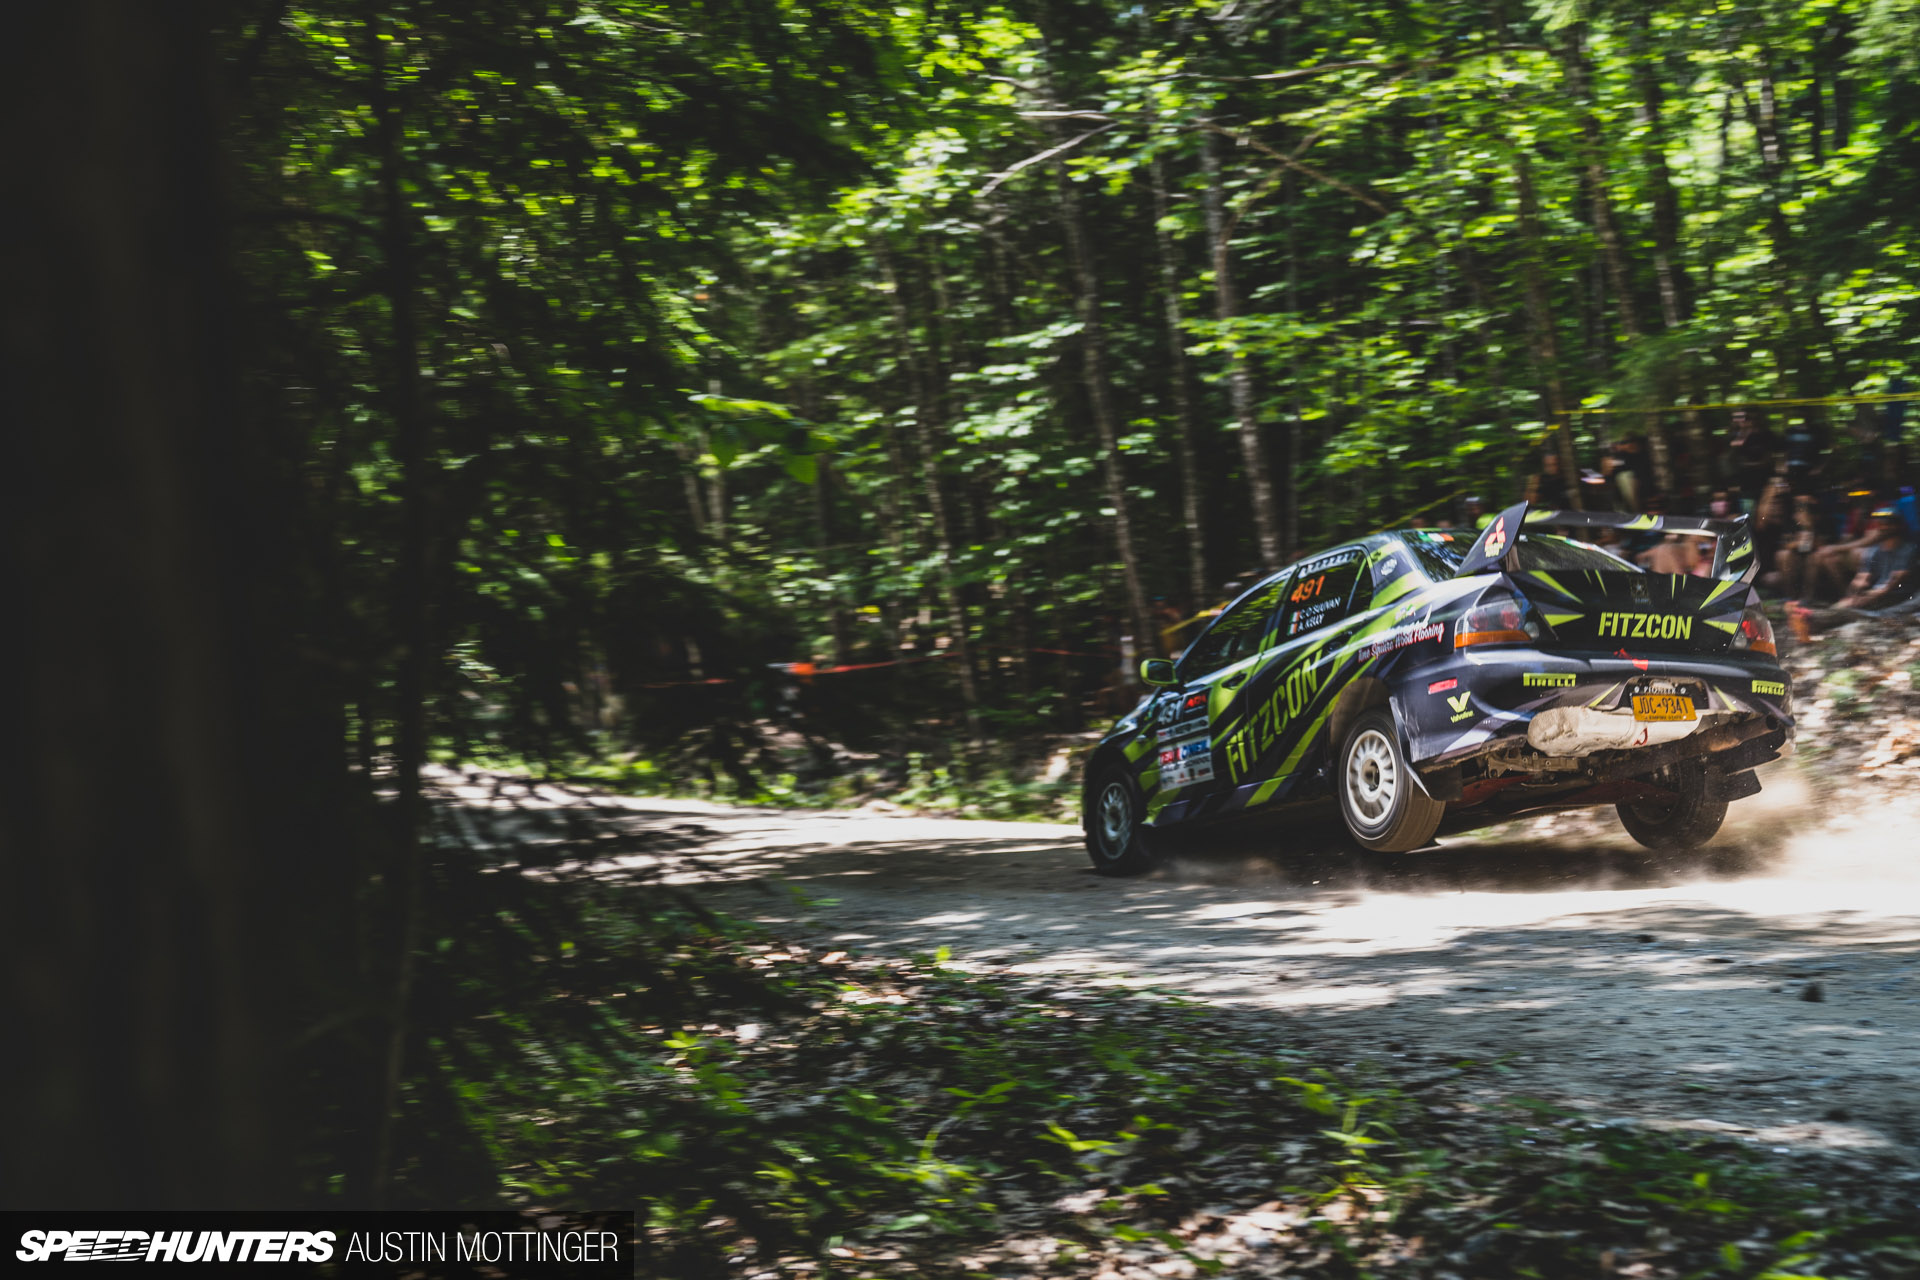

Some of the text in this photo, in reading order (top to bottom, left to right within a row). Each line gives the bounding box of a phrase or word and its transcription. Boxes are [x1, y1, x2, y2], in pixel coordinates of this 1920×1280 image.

[1291, 575, 1325, 603] 491
[1412, 621, 1445, 643] Flooring
[1598, 611, 1693, 640] FITZCON
[1523, 672, 1576, 687] PIRELLI
[1751, 679, 1785, 696] PIRELLI
[1225, 649, 1323, 785] FITZCON
